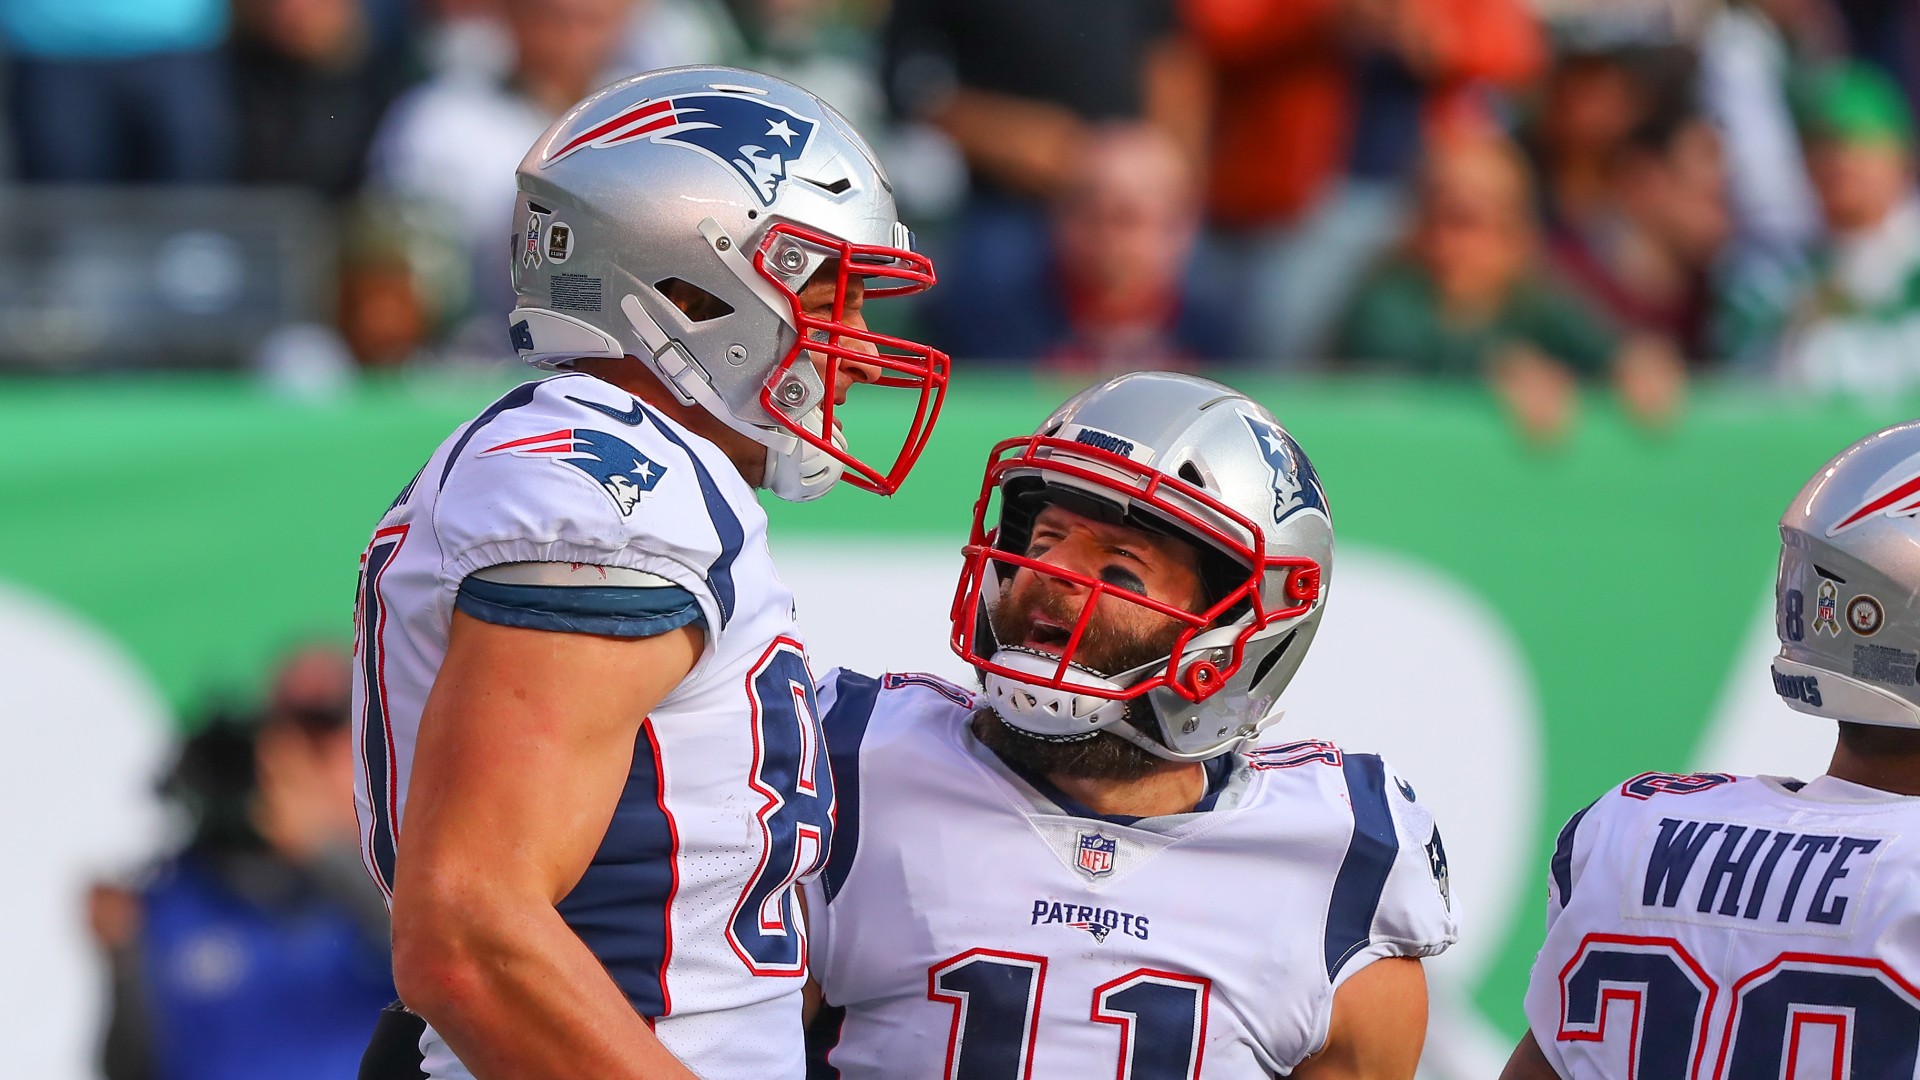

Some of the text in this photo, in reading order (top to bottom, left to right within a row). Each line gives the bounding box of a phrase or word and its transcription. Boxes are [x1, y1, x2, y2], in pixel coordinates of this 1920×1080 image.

[1819, 607, 1834, 621] NFL
[1081, 850, 1111, 871] NFL
[1642, 818, 1881, 925] WHITE
[1031, 900, 1149, 940] PATRIOTS
[927, 947, 1212, 1080] 11
